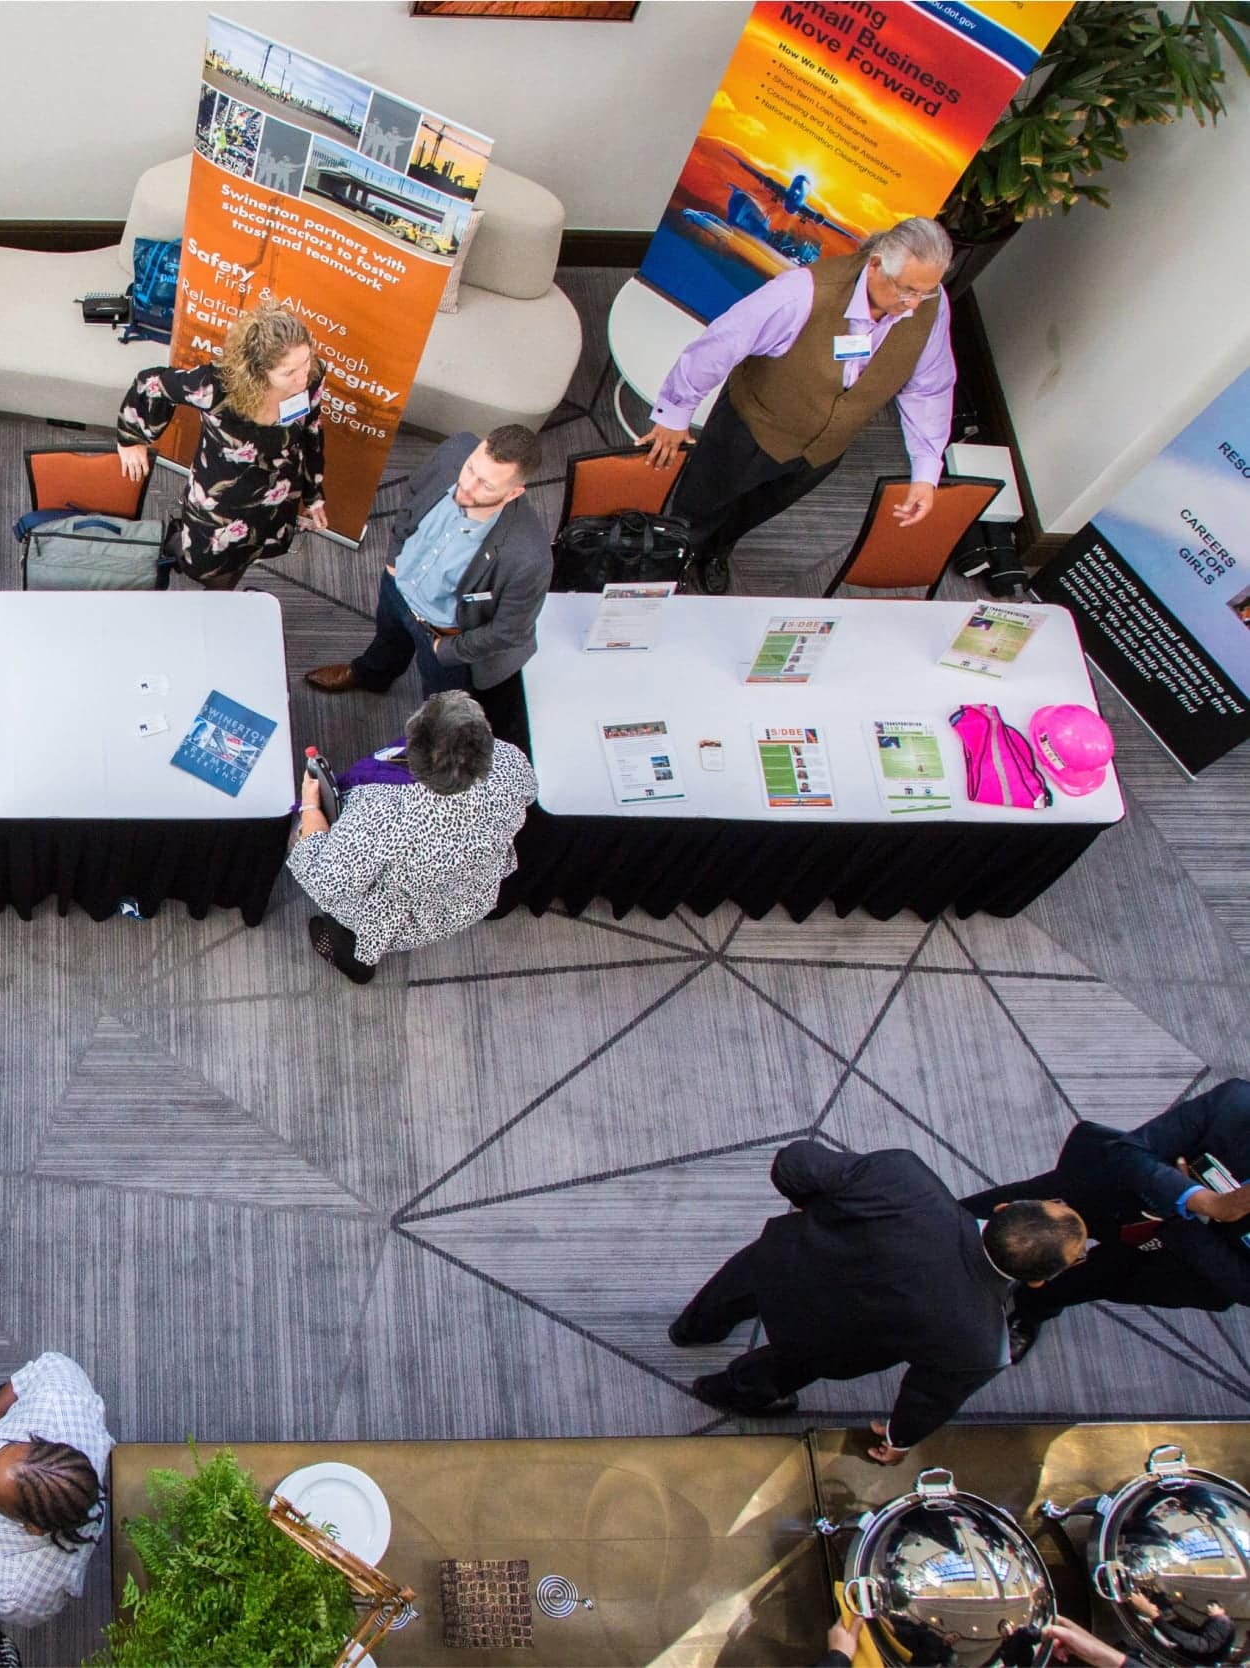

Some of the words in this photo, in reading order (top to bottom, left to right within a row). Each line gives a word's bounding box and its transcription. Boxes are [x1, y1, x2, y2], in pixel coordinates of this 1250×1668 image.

[778, 42, 799, 60] How
[801, 56, 816, 70] We
[817, 66, 839, 85] Help
[780, 5, 842, 53] Move
[845, 46, 943, 118] Forward
[856, 26, 961, 105] Business
[186, 238, 255, 282] Safety
[221, 184, 300, 222] Swinerton
[303, 219, 369, 255] partners
[373, 250, 407, 274] with
[221, 201, 334, 251] subcontractors
[337, 247, 352, 260] to
[356, 255, 401, 285] foster
[231, 219, 268, 239] trust
[271, 233, 302, 251] and
[305, 246, 383, 292] teamwork
[214, 271, 254, 295] First
[258, 287, 272, 301] &
[280, 296, 348, 337] Always
[1179, 547, 1215, 586] GIRLS
[1180, 508, 1237, 568] CAREERS
[1198, 548, 1226, 577] FOR
[1059, 576, 1091, 612] careers
[1089, 610, 1100, 622] in
[1075, 561, 1128, 620] construction
[1126, 616, 1146, 639] and
[1143, 638, 1205, 706] transportation
[1083, 552, 1117, 590] training
[1115, 588, 1131, 605] for
[1128, 603, 1155, 632] small
[1152, 630, 1203, 687] businesses
[1200, 684, 1212, 698] in
[1210, 697, 1228, 715] the
[1092, 544, 1107, 561] We
[1105, 560, 1140, 598] provide
[1138, 597, 1181, 641] technical
[1178, 638, 1225, 694] assistance
[1222, 692, 1245, 715] and
[1105, 610, 1121, 628] We
[1118, 624, 1140, 650] also
[1138, 649, 1159, 672] help
[1158, 671, 1179, 694] girls
[1177, 693, 1198, 715] find
